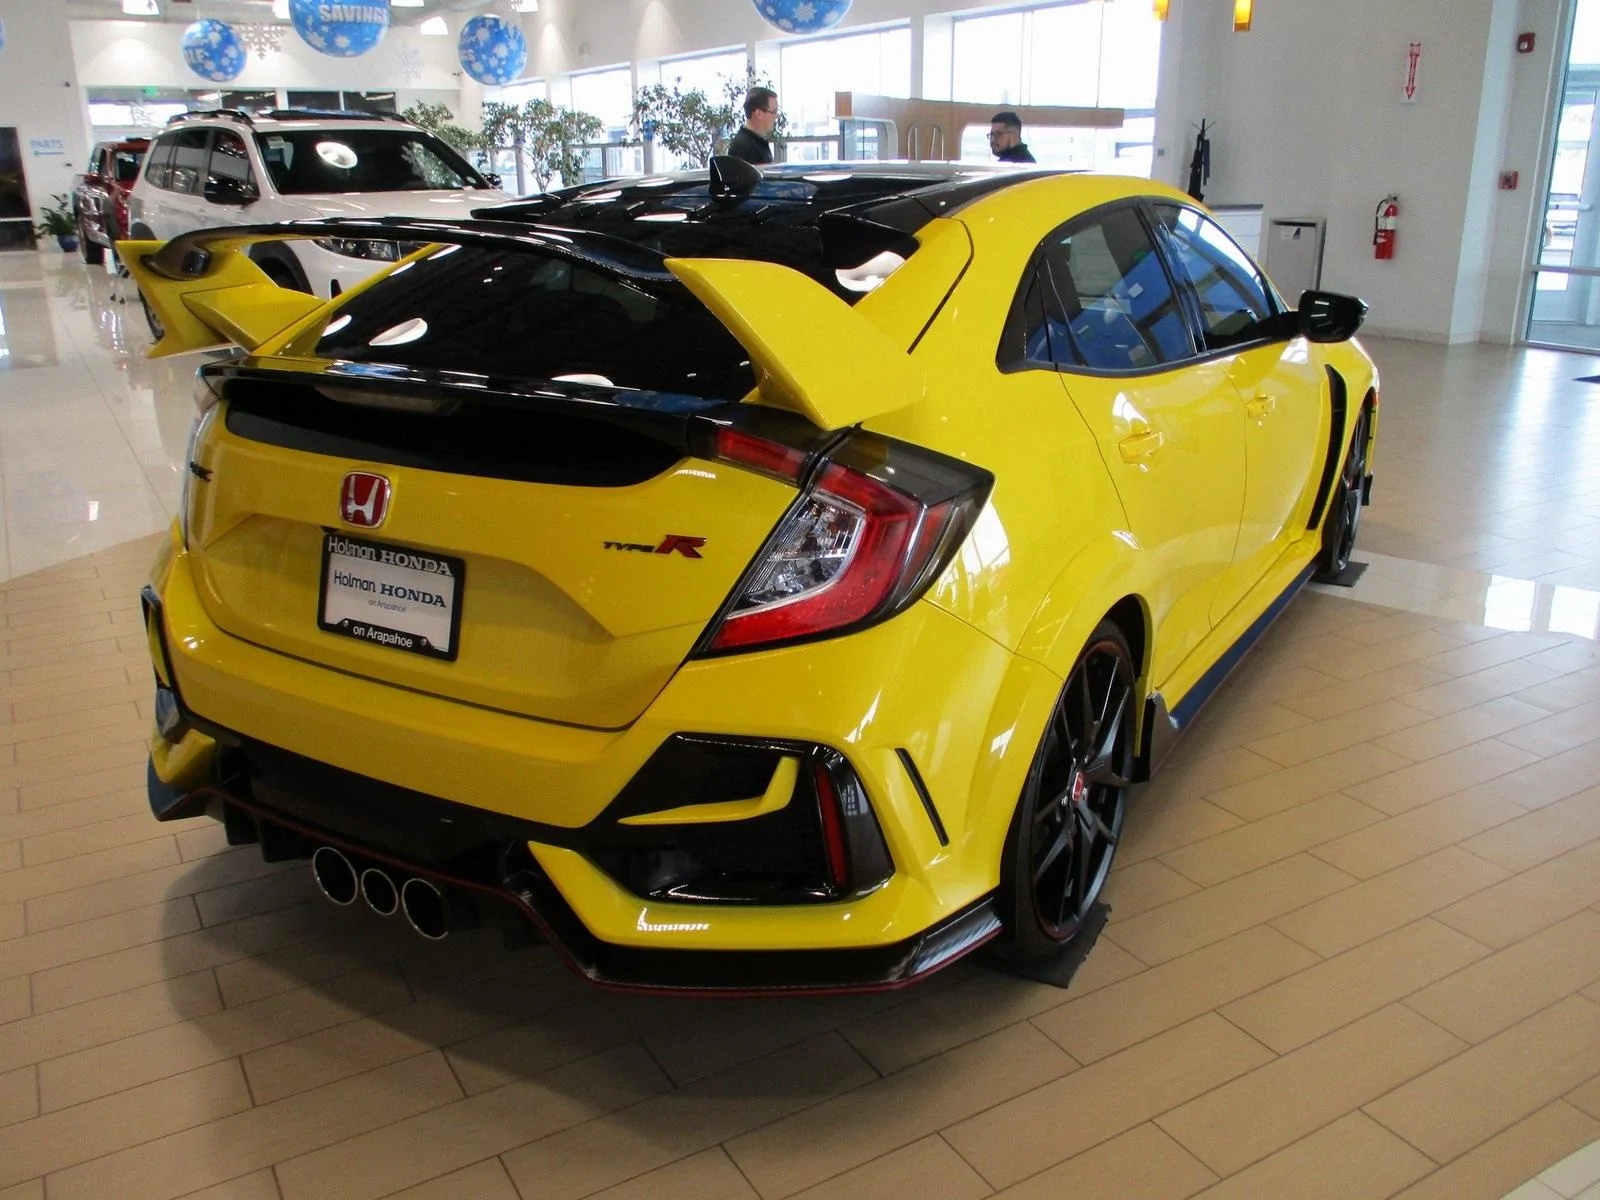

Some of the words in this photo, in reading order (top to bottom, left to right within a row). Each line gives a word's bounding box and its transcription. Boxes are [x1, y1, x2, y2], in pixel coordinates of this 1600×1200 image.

[30, 139, 64, 150] PARTS
[328, 536, 376, 561] Holman
[380, 549, 453, 577] HONDA
[603, 541, 656, 553] TYPE
[654, 534, 708, 559] R
[334, 570, 376, 593] Holman
[380, 583, 447, 608] HONDA
[353, 626, 365, 636] on
[366, 627, 413, 648] Arapahoe
